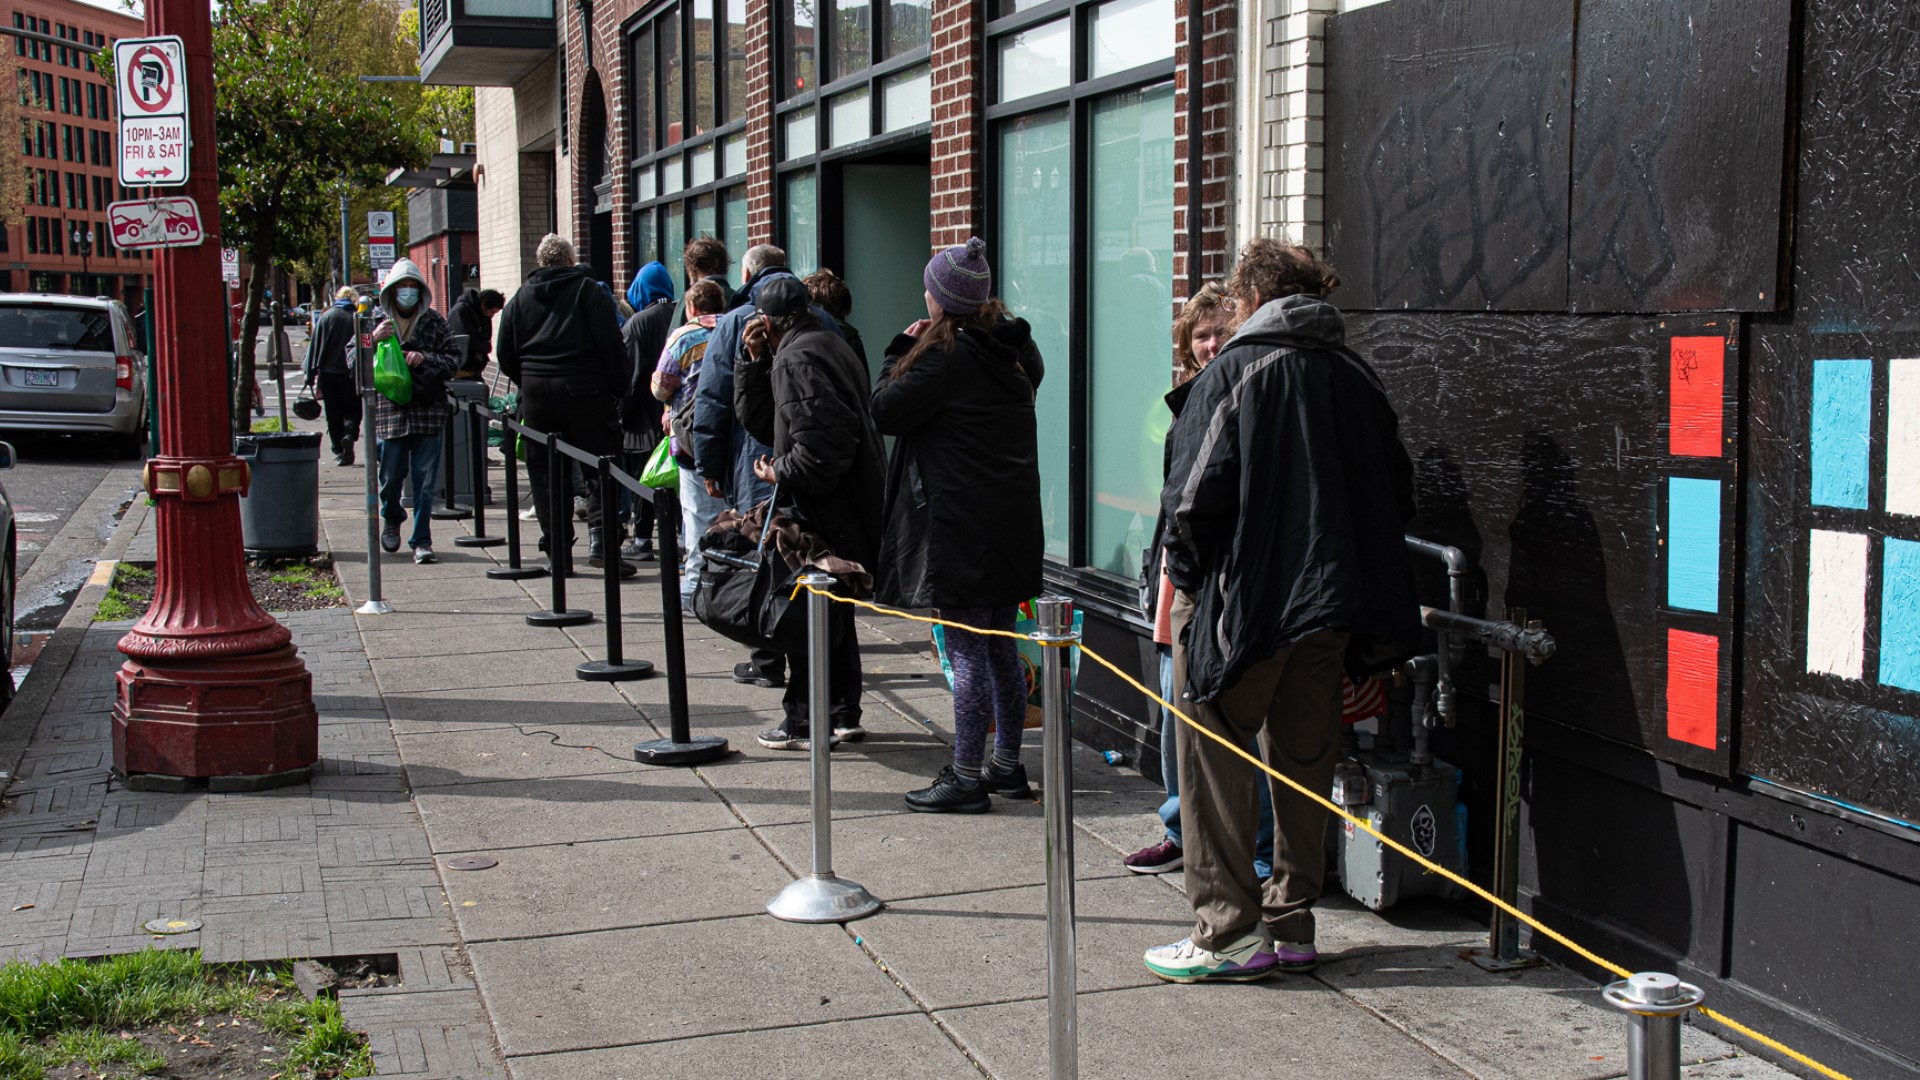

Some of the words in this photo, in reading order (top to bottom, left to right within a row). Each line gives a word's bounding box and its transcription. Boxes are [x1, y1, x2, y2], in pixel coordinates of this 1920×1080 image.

[126, 126, 180, 141] 10PM-3AM
[125, 144, 144, 159] FRI
[147, 144, 155, 159] &
[159, 143, 183, 158] SAT
